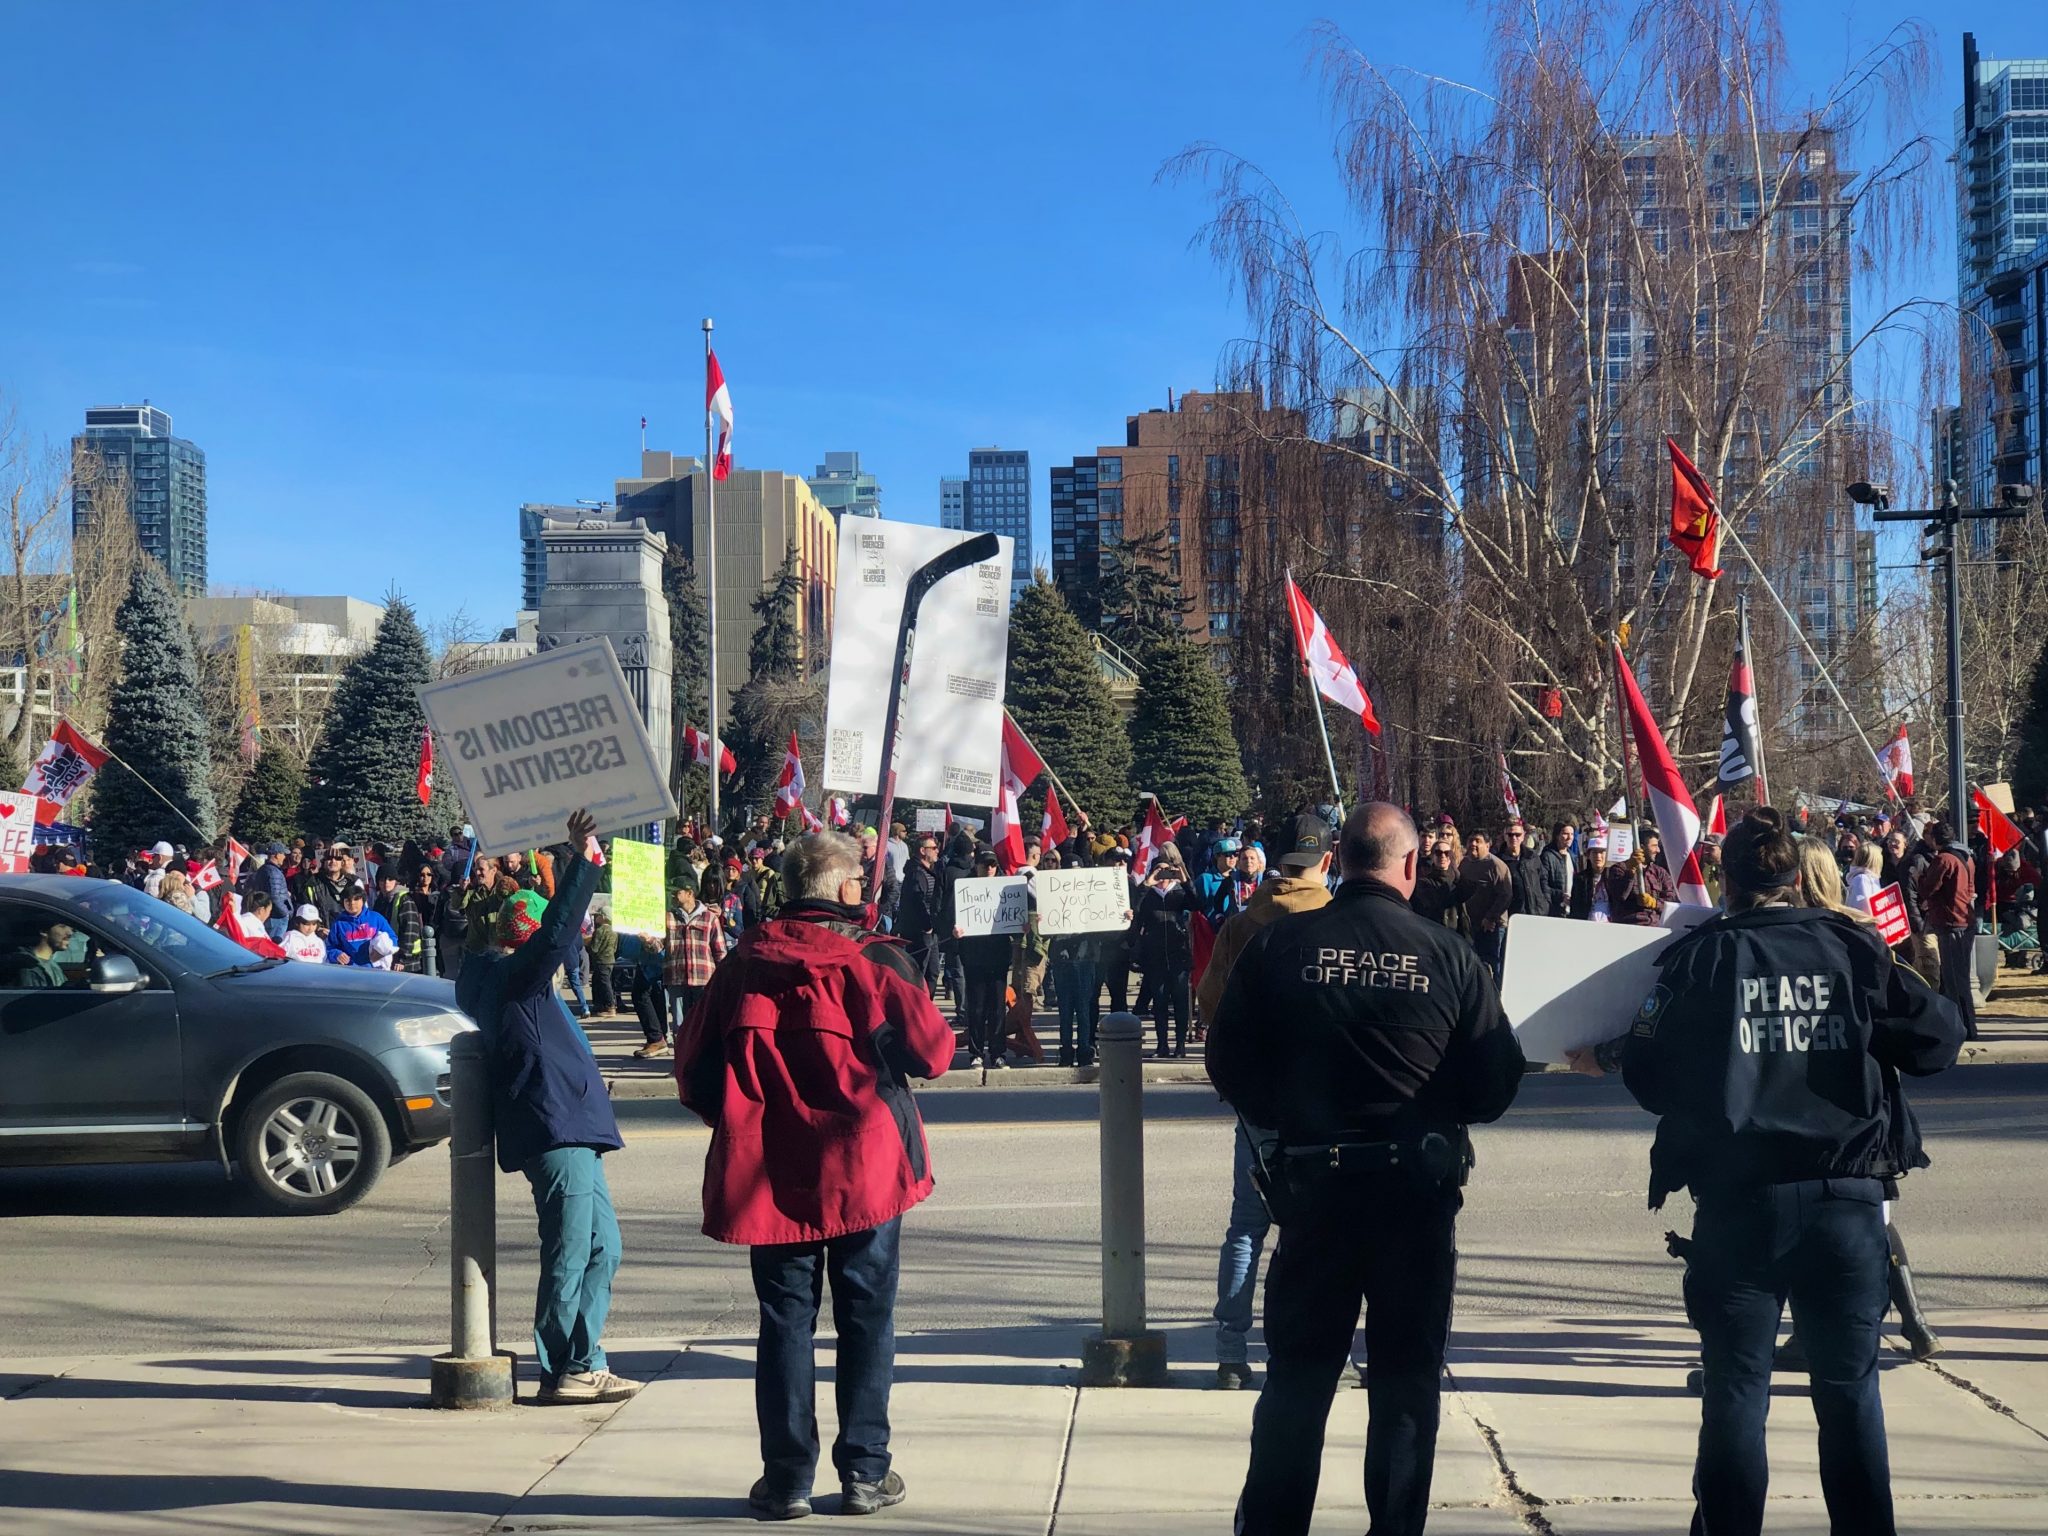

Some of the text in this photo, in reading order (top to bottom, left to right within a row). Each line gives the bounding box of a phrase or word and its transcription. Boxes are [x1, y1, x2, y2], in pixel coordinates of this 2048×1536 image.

[840, 729, 851, 737] YOU
[852, 730, 864, 738] ARE
[832, 742, 849, 750] YOUR
[946, 771, 959, 780] LIKE
[960, 773, 992, 786] LIVESTOCK
[1049, 874, 1108, 893] Delete
[958, 886, 1021, 905] Thank you
[1059, 894, 1096, 912] your
[1875, 892, 1898, 912] SUPPORT
[959, 905, 1027, 928] TRUCKERS
[1047, 904, 1116, 928] QR Code
[1317, 947, 1419, 973] PEACE
[1301, 965, 1431, 994] OFFICER
[1742, 975, 1831, 1013] PEACE
[1739, 1015, 1849, 1054] OFFICER
